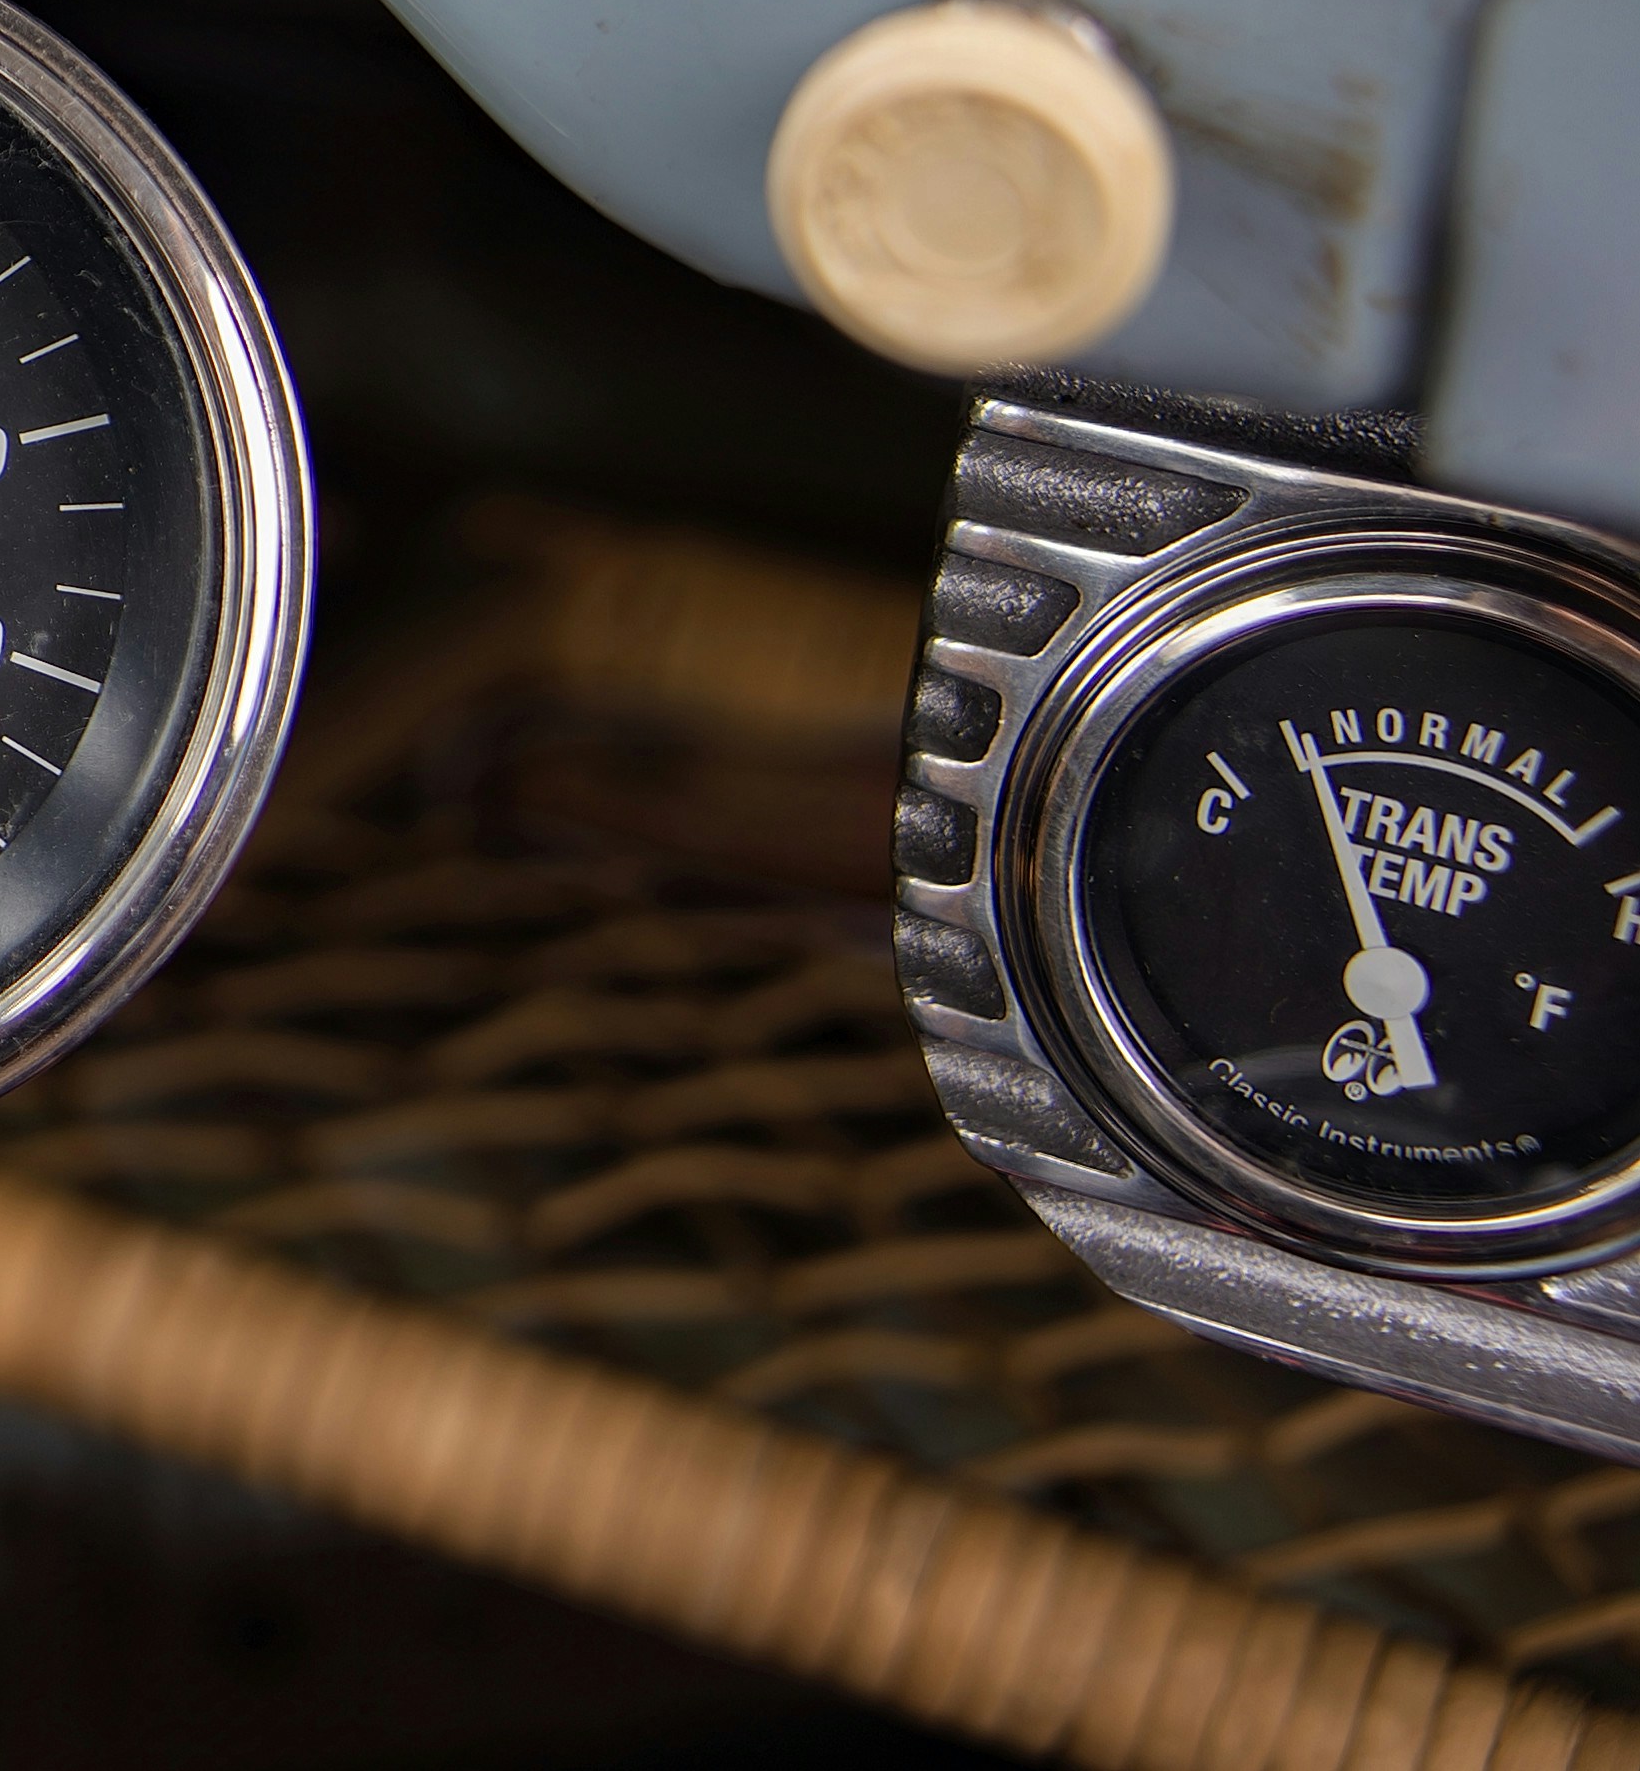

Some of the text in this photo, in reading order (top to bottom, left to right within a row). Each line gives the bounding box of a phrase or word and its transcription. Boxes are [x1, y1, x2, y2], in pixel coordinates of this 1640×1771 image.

[1330, 707, 1577, 808] NORMAL
[1196, 787, 1233, 834] C
[1340, 786, 1515, 873] TRANS
